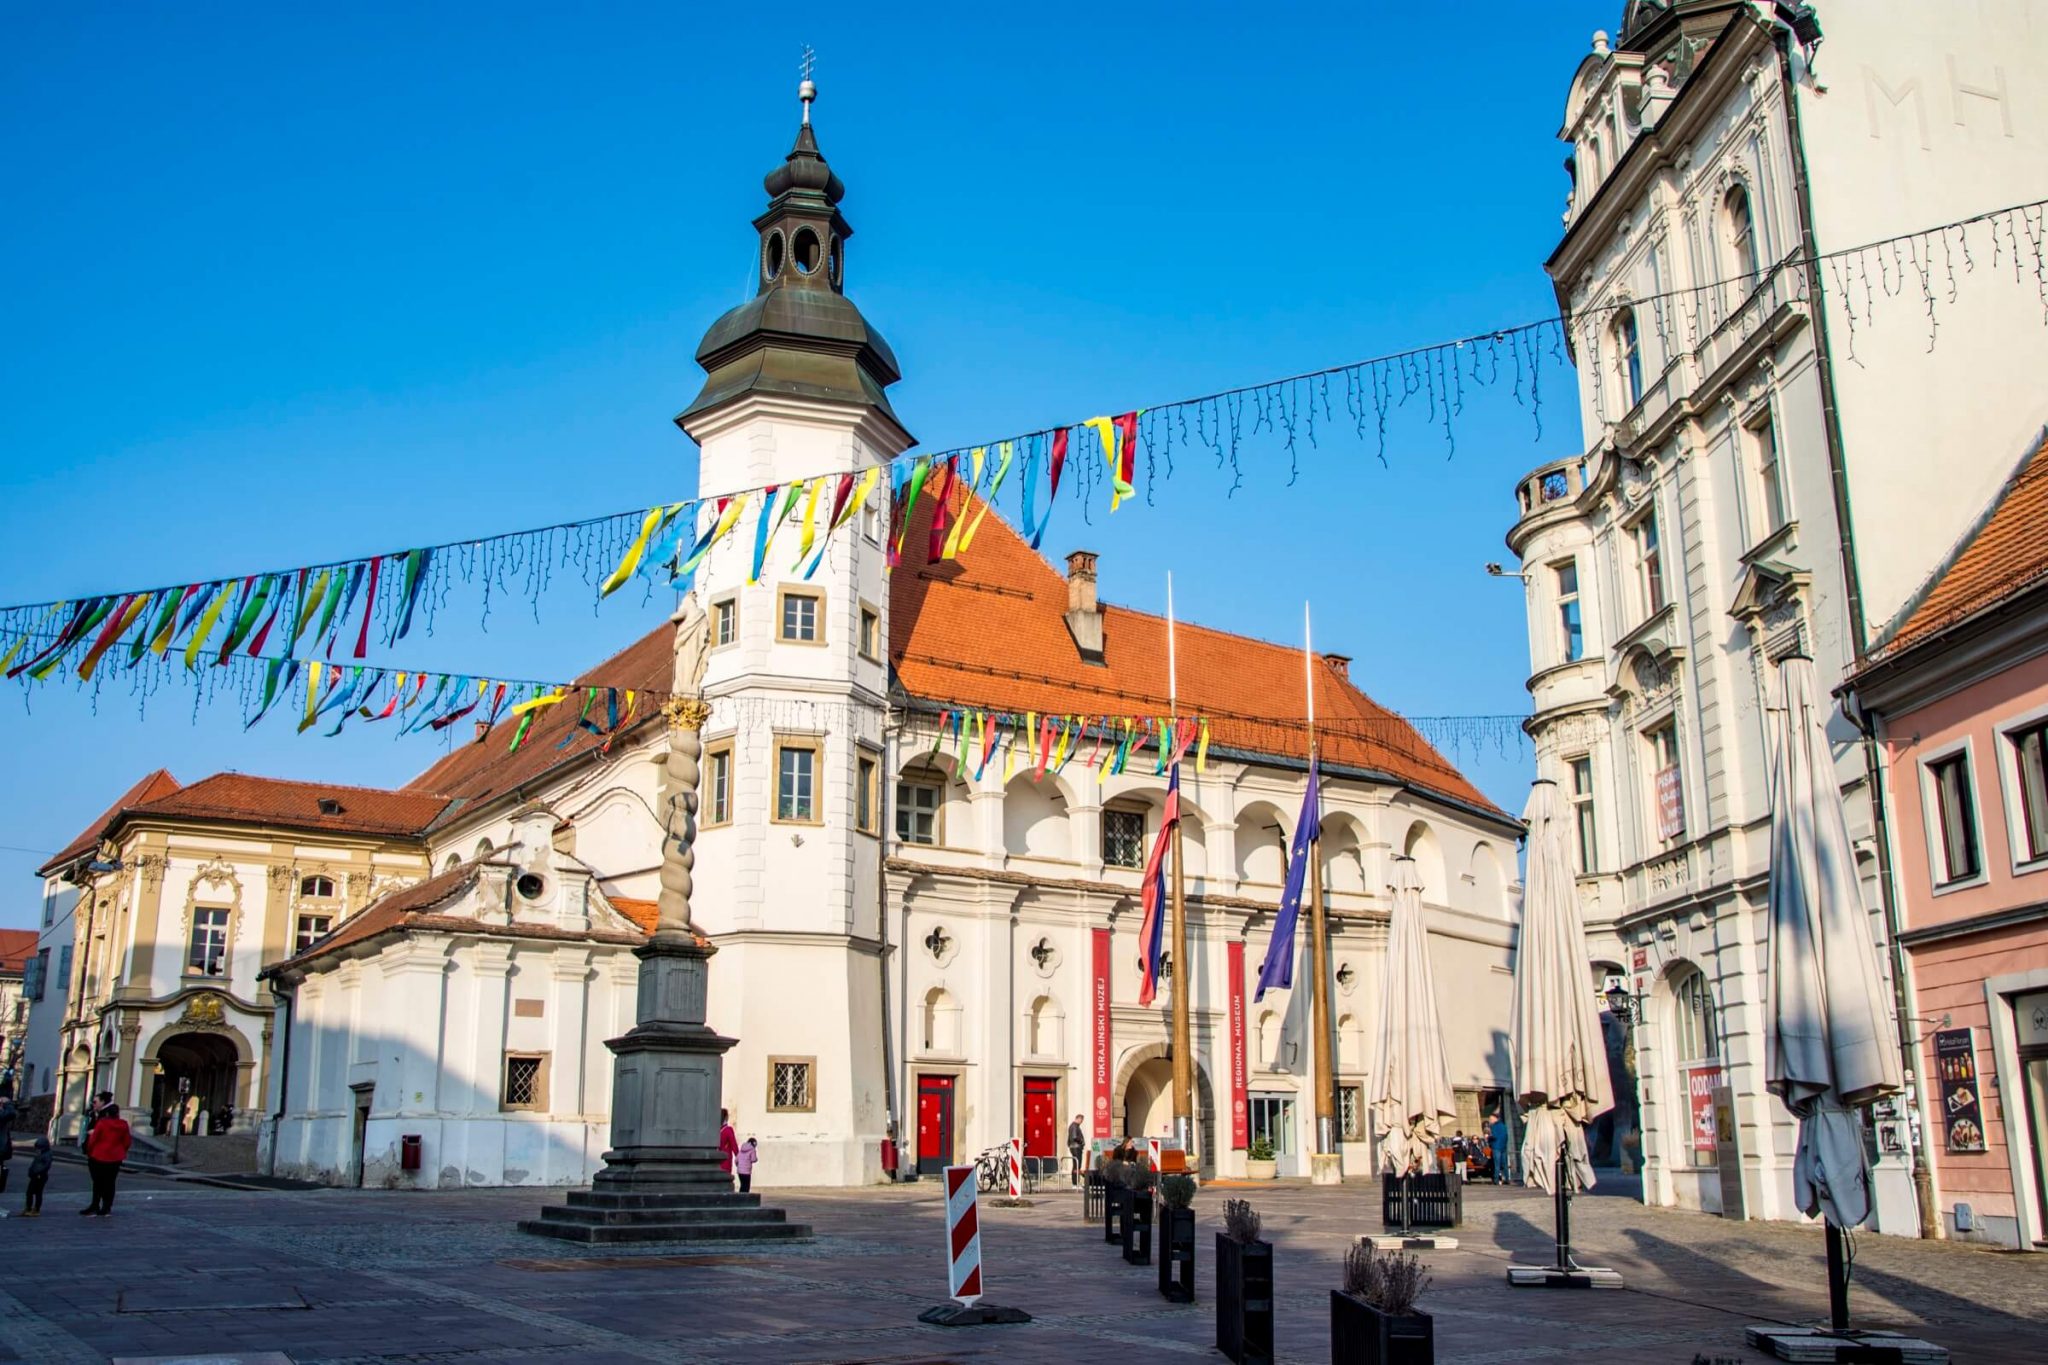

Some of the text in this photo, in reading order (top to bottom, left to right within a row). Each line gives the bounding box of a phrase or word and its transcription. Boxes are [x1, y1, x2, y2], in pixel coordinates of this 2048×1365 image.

[1097, 977, 1105, 1084] POKRAJINSKI MUZEJ
[1235, 1039, 1243, 1089] REGIONAL
